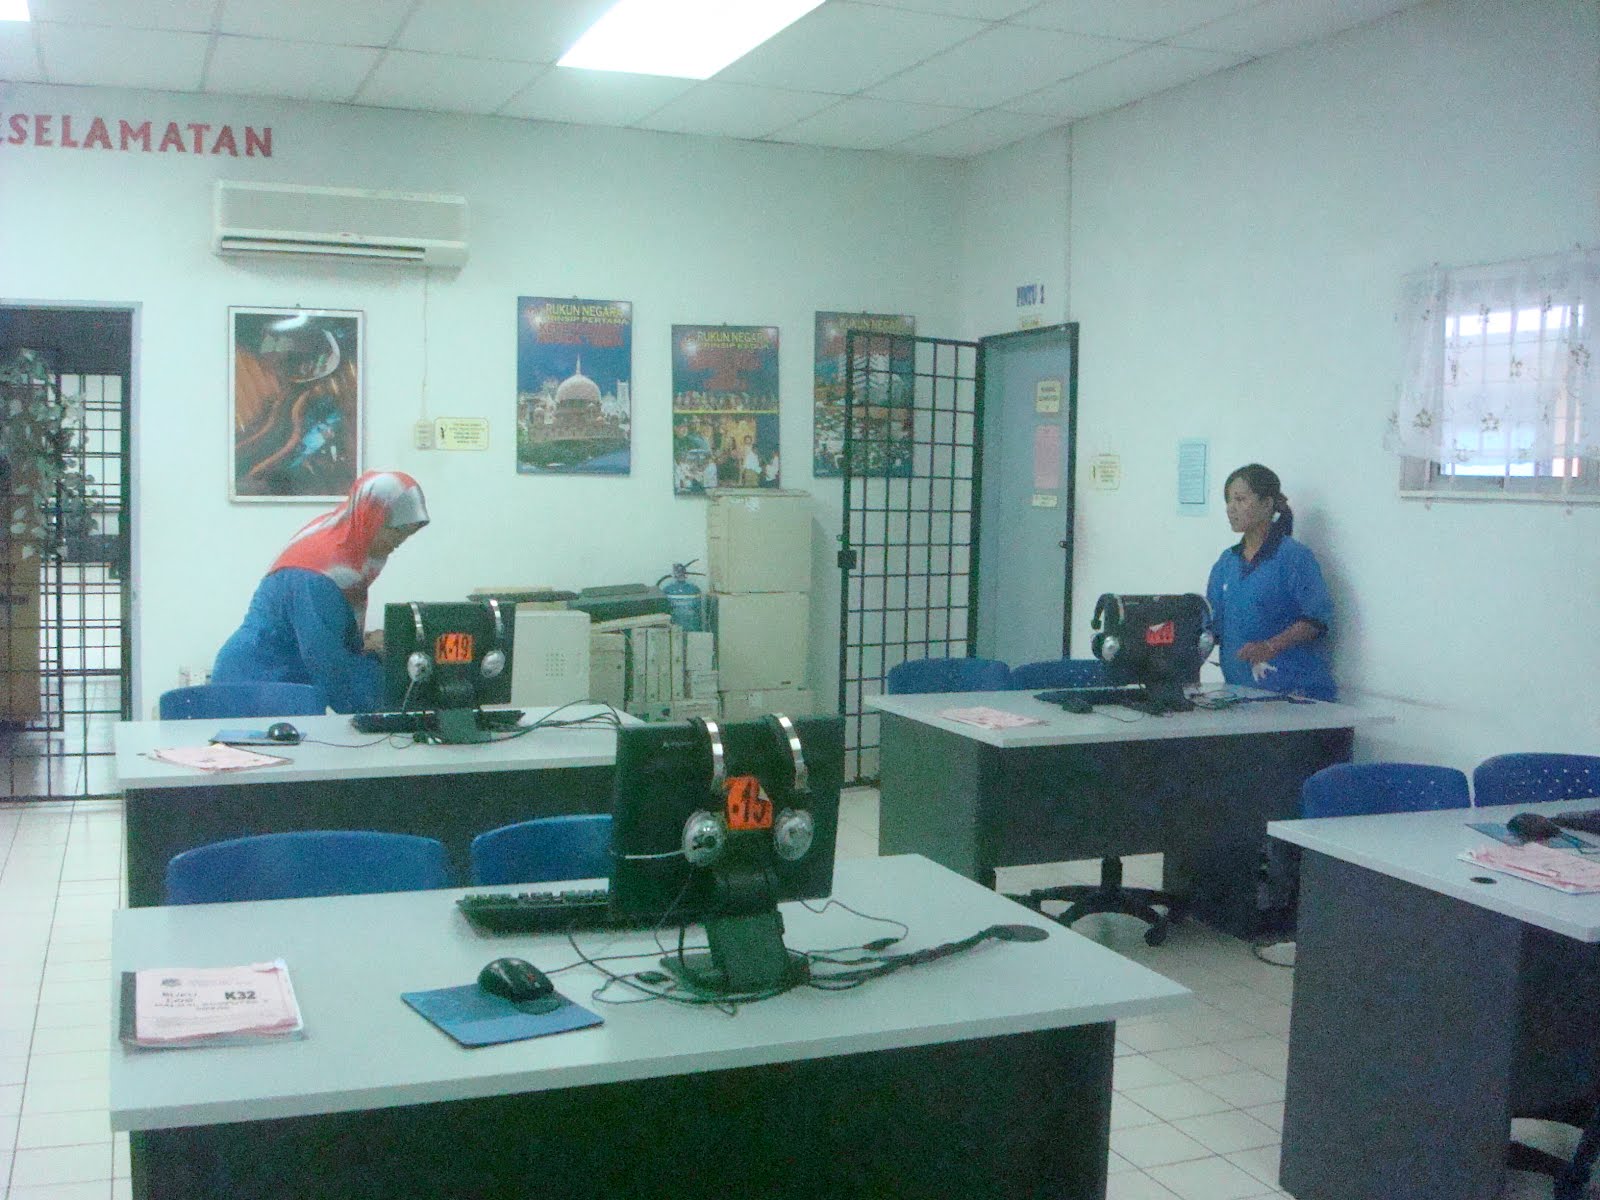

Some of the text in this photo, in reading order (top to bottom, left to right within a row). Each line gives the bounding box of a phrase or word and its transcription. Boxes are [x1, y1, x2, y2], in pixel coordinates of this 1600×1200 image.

[0, 112, 273, 158] SELAMATAN
[545, 303, 580, 316] RUKUN
[697, 331, 730, 342] RUKUN
[225, 990, 256, 1000] K32
